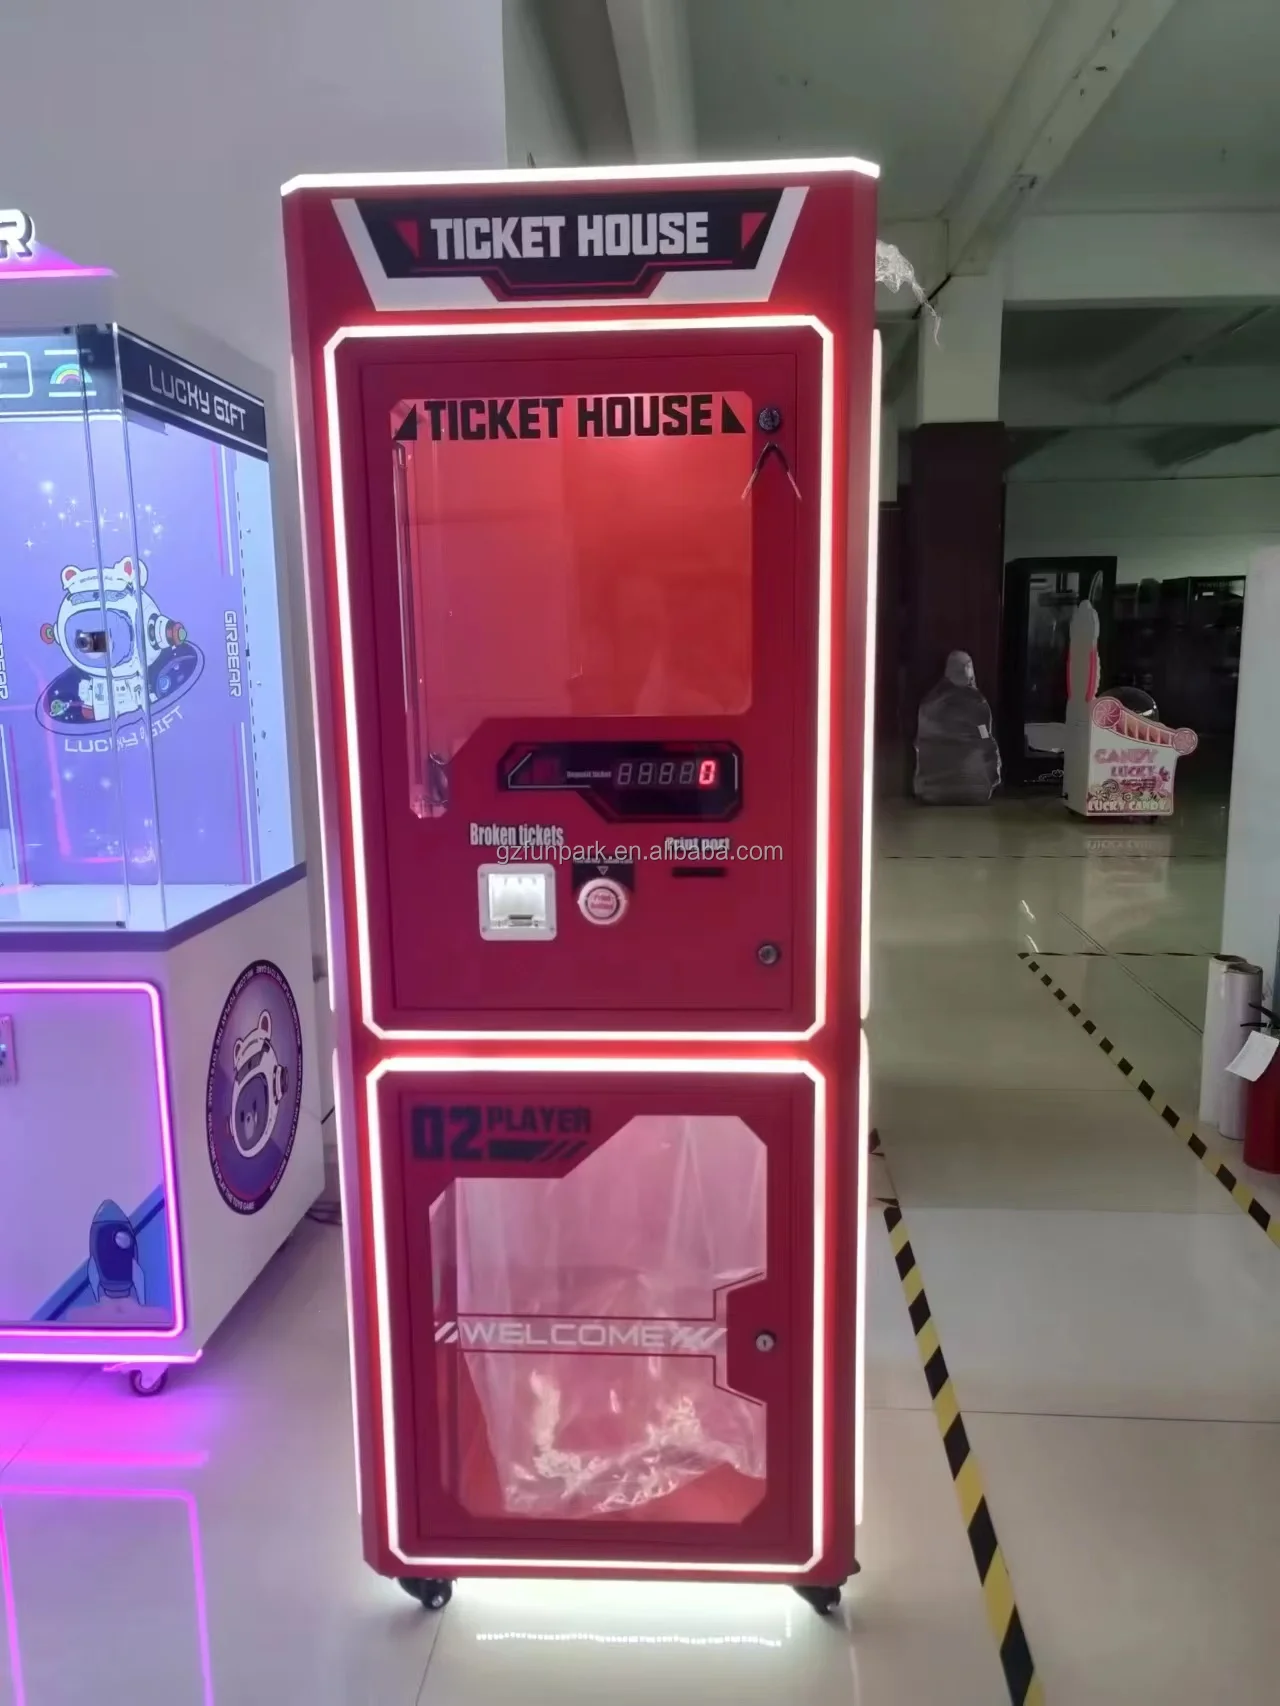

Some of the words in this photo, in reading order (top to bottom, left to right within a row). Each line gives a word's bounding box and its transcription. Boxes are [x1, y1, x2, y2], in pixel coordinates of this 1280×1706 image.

[430, 216, 565, 260] TICKET
[577, 210, 709, 256] HOUSE
[148, 364, 210, 414] LUCKY
[213, 395, 247, 432] GIFT
[423, 398, 564, 441] TICKET
[577, 394, 714, 437] HOUSE
[223, 609, 242, 697] GIRBEAR
[1094, 748, 1158, 764] CANDY
[1088, 800, 1126, 811] LUCKY
[1128, 800, 1167, 811] CANDY
[470, 823, 516, 846] Broken
[518, 824, 564, 846] tickets
[411, 1105, 484, 1162] 02
[486, 1106, 590, 1133] PLAYER
[459, 1322, 666, 1347] WELCOME
